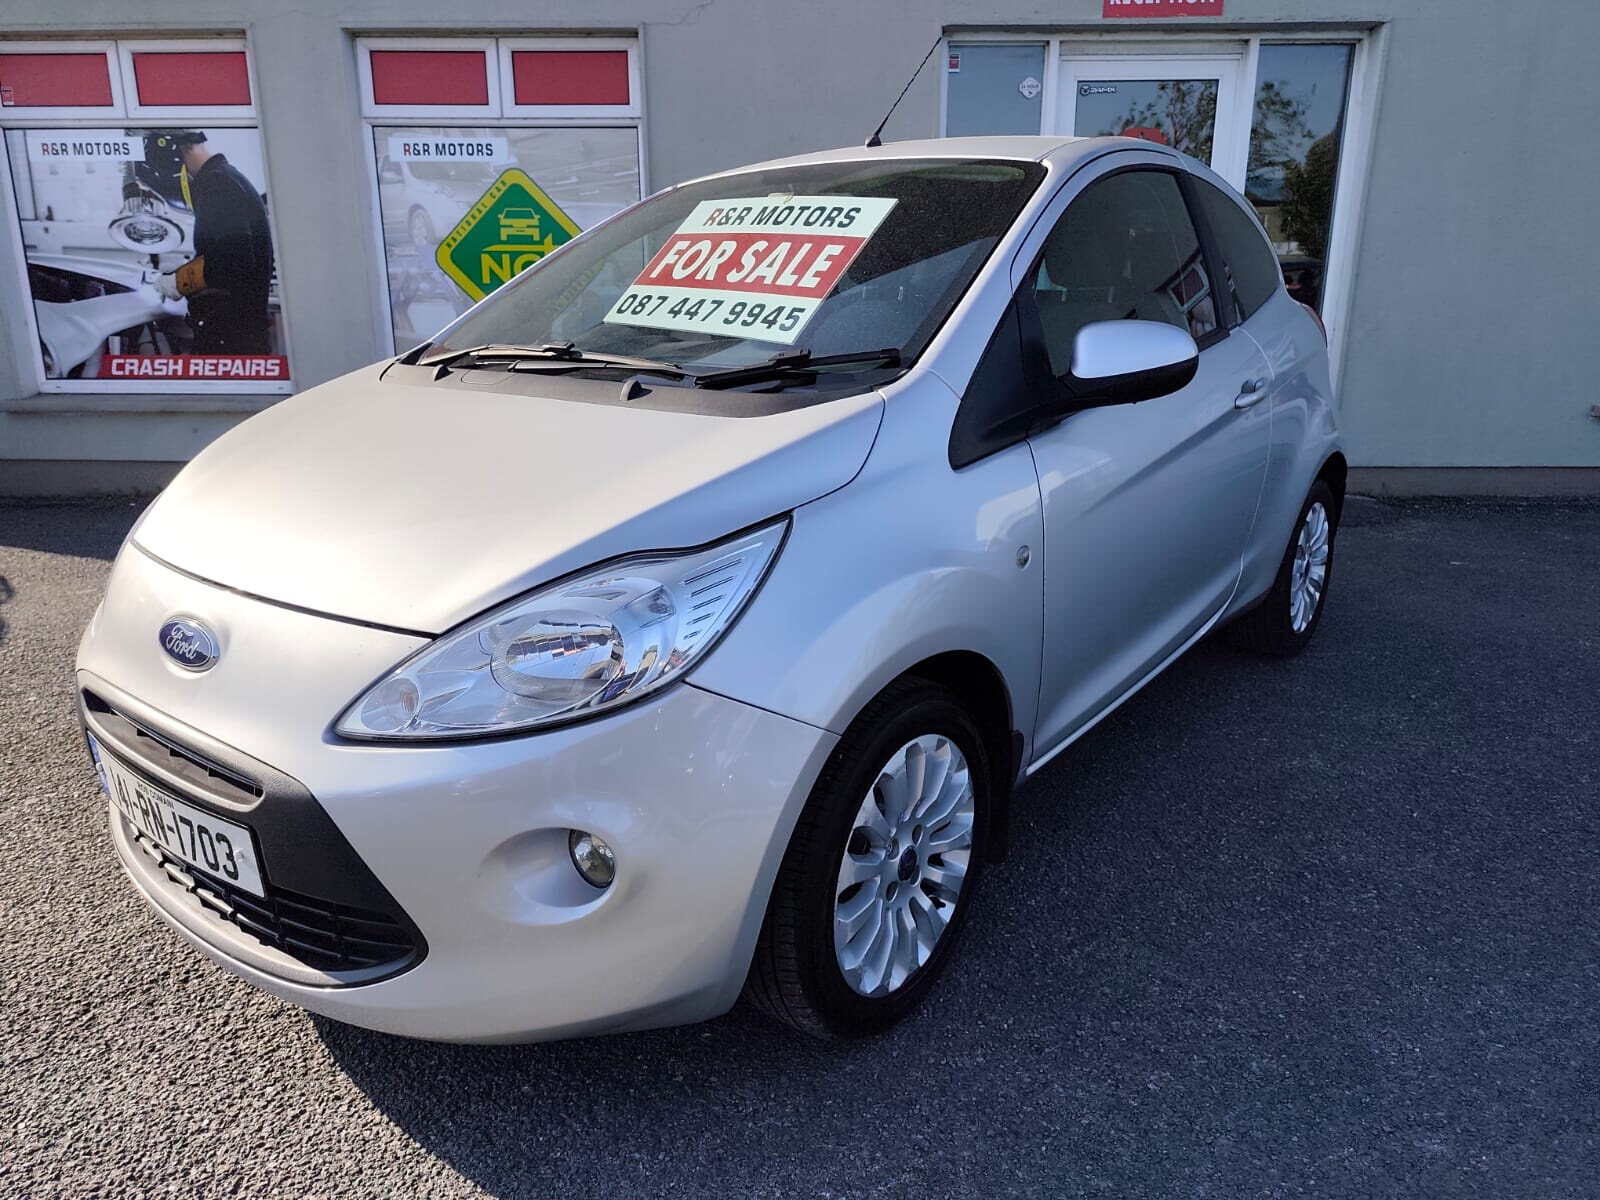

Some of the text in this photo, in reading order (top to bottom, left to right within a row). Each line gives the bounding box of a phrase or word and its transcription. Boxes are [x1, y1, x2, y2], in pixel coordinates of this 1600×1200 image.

[41, 142, 130, 156] R&R MOTORS
[403, 143, 494, 156] R&R MOTORS
[446, 179, 508, 250] NATIONAL CAR
[703, 205, 861, 228] R&R MOTORS
[650, 239, 845, 288] FOR SALE
[616, 293, 805, 332] 087 447 9945
[111, 358, 280, 377] CRASH REPAIRS
[166, 624, 200, 659] Ford
[110, 766, 239, 881] 141-RN-1703
